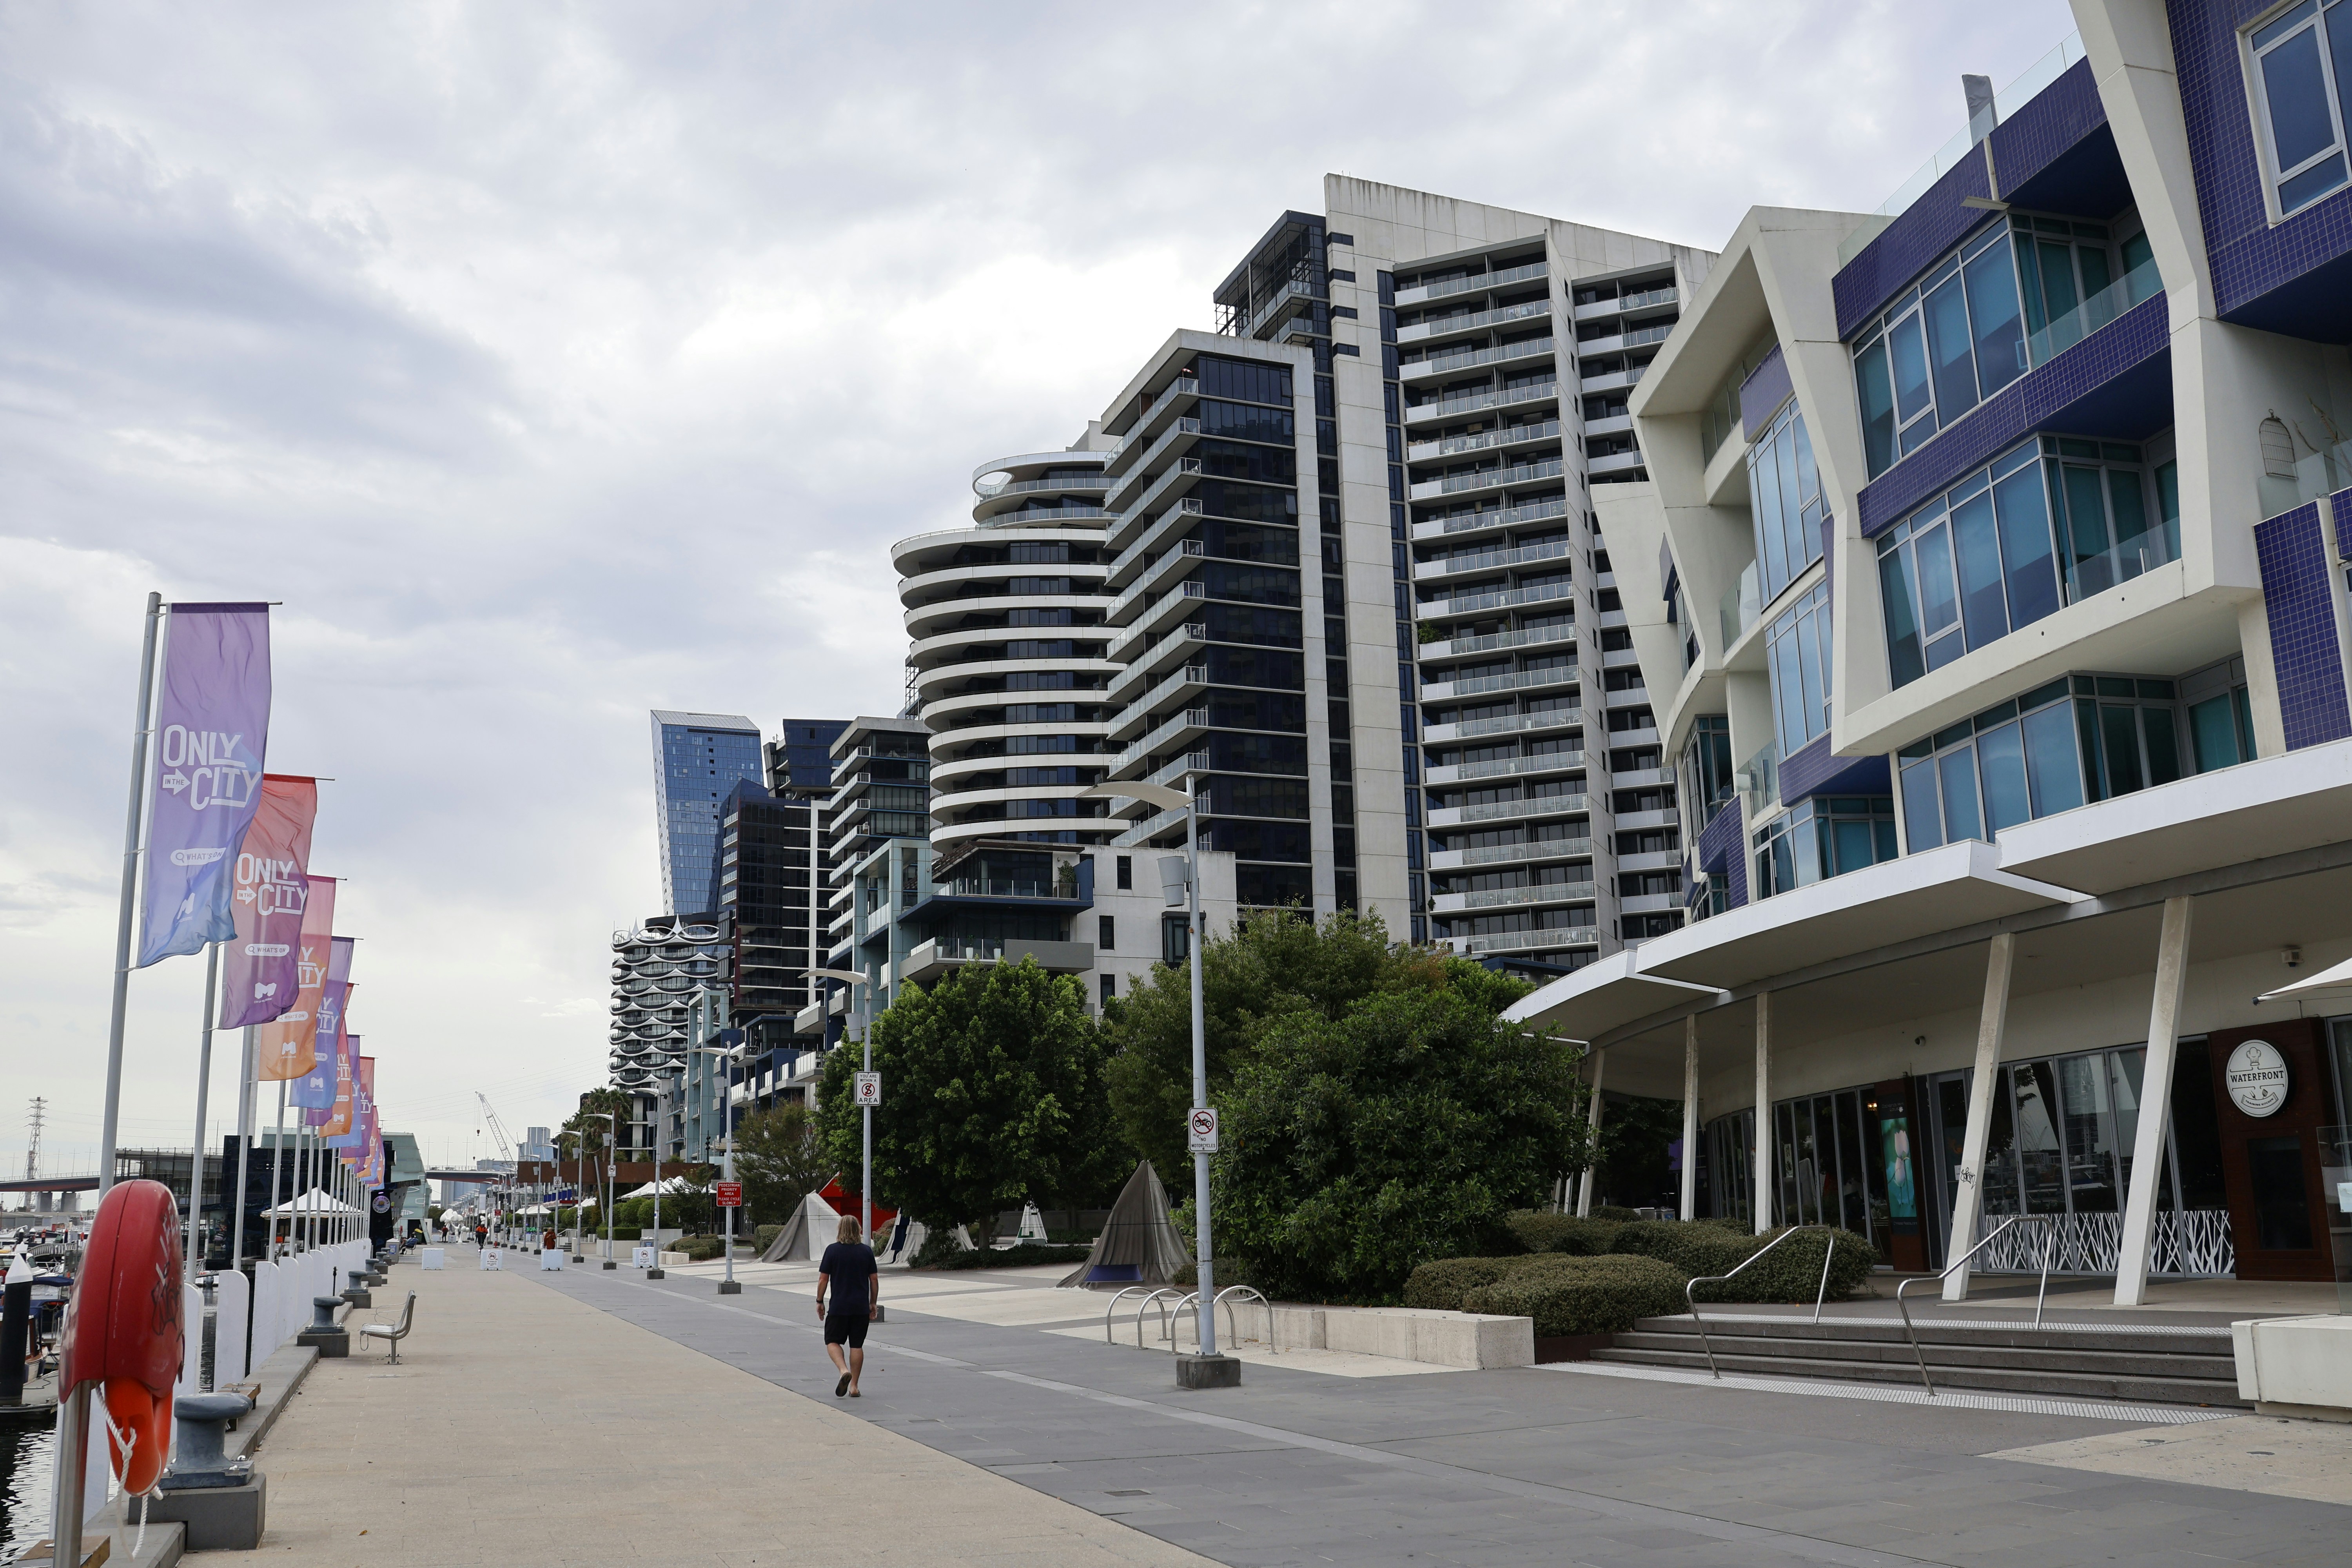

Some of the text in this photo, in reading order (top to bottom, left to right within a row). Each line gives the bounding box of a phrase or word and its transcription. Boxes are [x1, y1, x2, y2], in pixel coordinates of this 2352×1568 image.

[163, 724, 247, 768] ONLY
[190, 767, 262, 810] CITY
[237, 853, 299, 886] ONLY
[258, 884, 308, 916] CITY
[298, 967, 326, 988] ITY
[337, 1054, 349, 1066] LY
[2230, 1071, 2284, 1083] WATERFRONT
